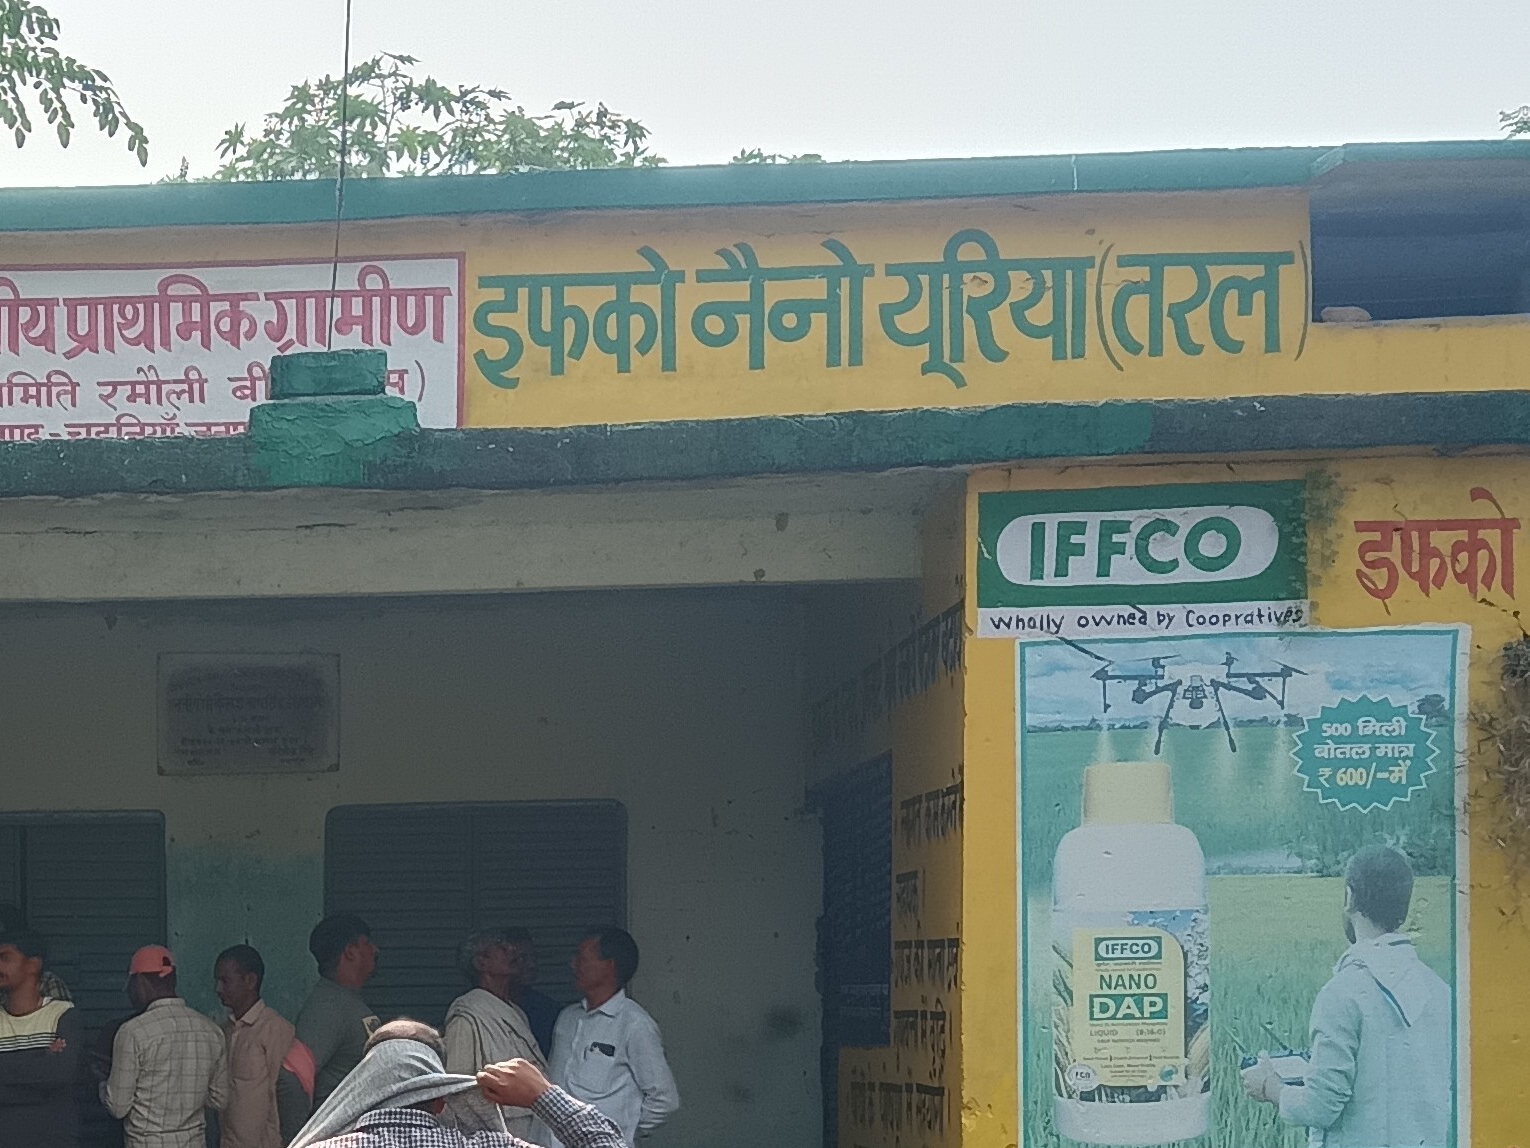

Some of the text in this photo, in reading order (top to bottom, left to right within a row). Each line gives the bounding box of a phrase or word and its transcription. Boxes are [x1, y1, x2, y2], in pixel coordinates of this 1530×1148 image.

[62, 272, 259, 359] प्राथमिक
[264, 264, 453, 356] ग्रामीण
[471, 245, 686, 389] इफको
[689, 238, 877, 371] नैनो
[1029, 516, 1242, 582] IFFCO
[1354, 486, 1521, 616] इफको
[1157, 611, 1174, 630] by
[1321, 716, 1407, 737] 500 मिली
[1313, 739, 1416, 759] बोतल मात्र
[1105, 942, 1152, 955] IFFCO
[1099, 973, 1158, 990] NANO
[1092, 996, 1164, 1019] DAP
